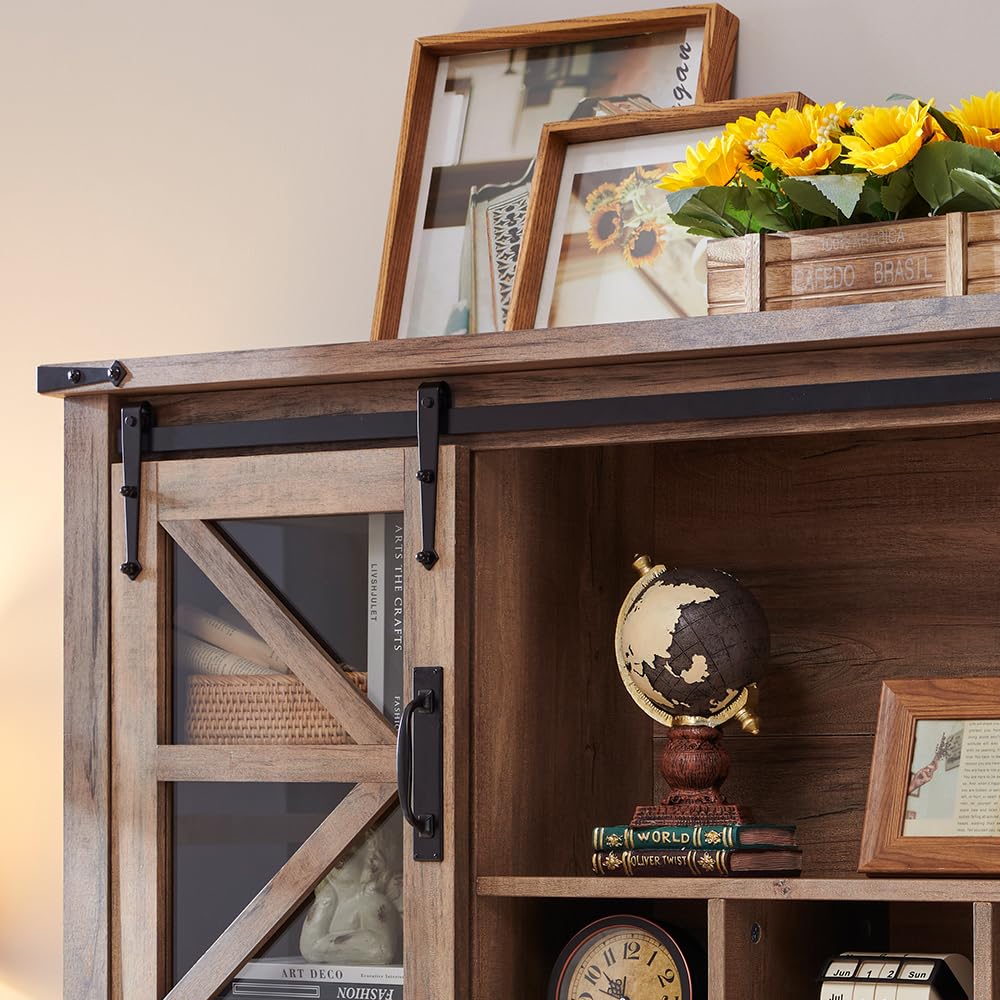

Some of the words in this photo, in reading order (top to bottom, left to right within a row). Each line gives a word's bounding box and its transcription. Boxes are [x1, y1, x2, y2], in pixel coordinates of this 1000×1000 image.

[672, 40, 693, 107] gan
[874, 256, 933, 283] BRASIL
[394, 524, 403, 561] ARTS
[394, 563, 404, 593] THE
[394, 596, 404, 653] CRAFTS
[637, 830, 690, 846] WORLD
[630, 854, 660, 867] OLIVER
[662, 854, 687, 866] TWIST
[603, 947, 617, 967] 11
[623, 941, 641, 960] 12
[646, 951, 658, 967] 1
[281, 968, 305, 979] ART
[310, 968, 344, 980] DECO
[584, 964, 602, 986] 10
[657, 968, 675, 988] 2
[832, 969, 851, 977] Jun
[866, 970, 873, 978] 1
[887, 970, 895, 978] 2
[337, 986, 394, 1000] FASHION
